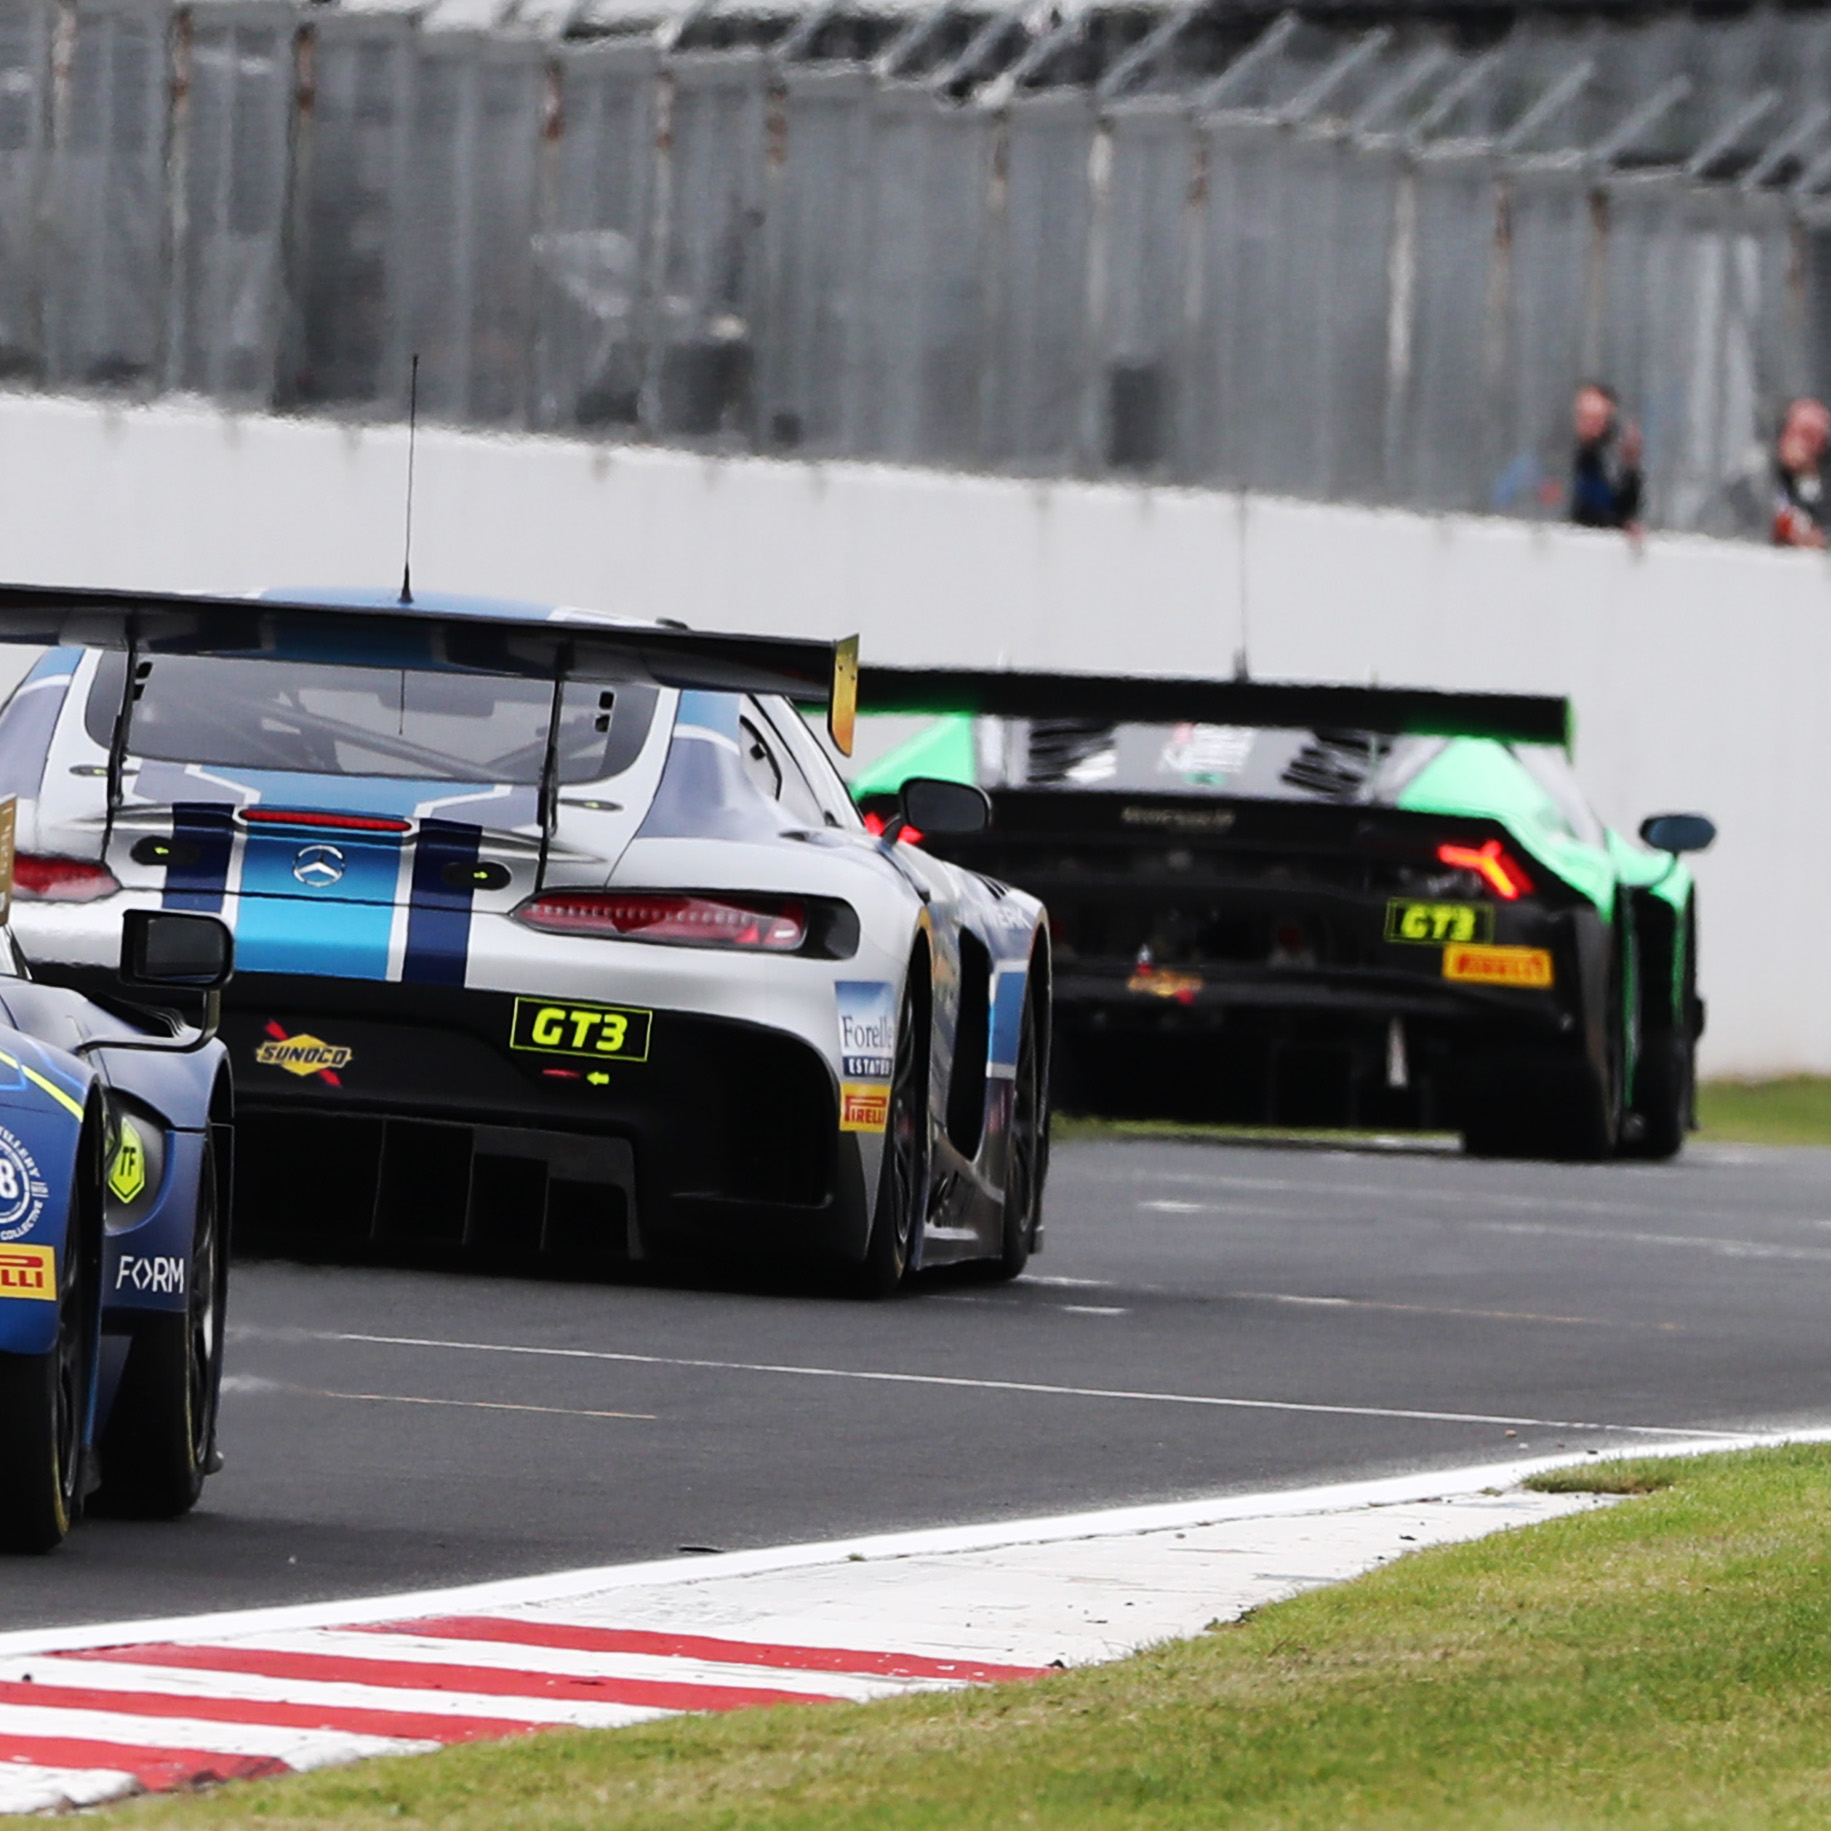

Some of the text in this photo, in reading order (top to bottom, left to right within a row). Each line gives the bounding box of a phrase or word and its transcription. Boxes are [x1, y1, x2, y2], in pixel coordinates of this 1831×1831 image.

[1401, 903, 1475, 942] GT3
[531, 1006, 629, 1053] GT3
[261, 1044, 350, 1067] SUNOCO
